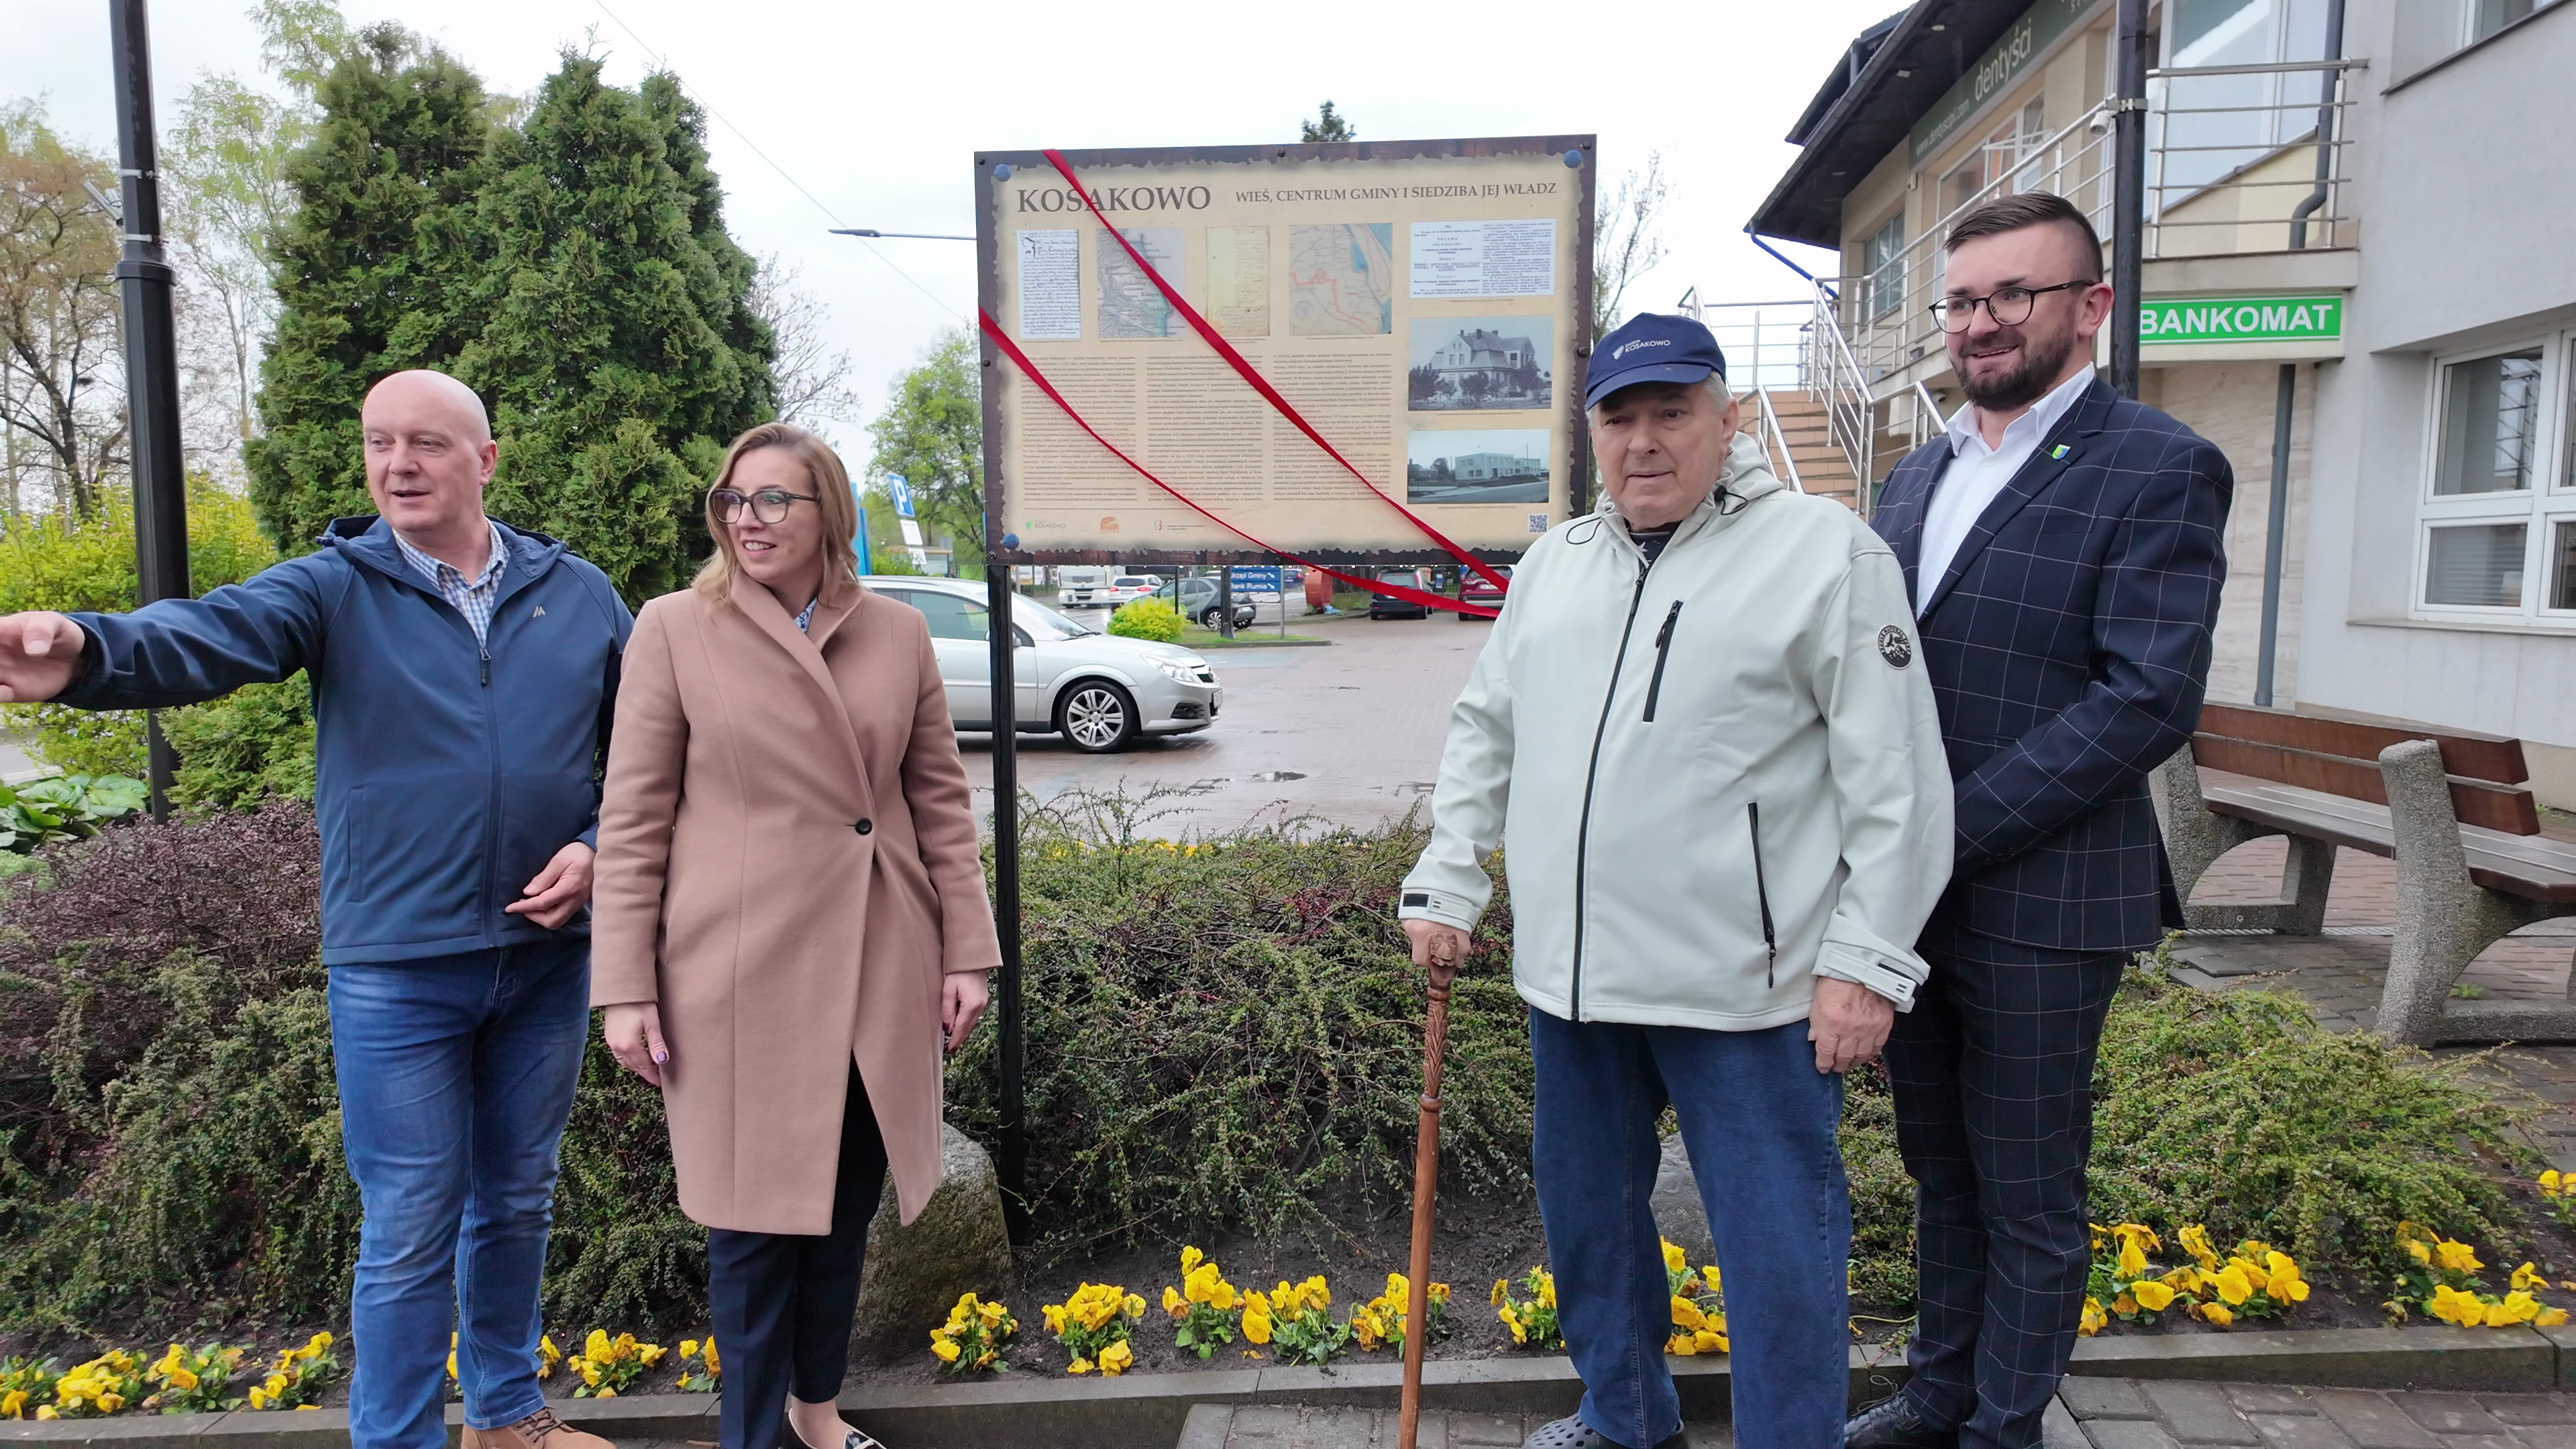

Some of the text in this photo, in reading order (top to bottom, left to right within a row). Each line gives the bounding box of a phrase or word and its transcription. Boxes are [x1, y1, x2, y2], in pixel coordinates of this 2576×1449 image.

[1975, 18, 2031, 101] dentyści
[1017, 186, 1211, 212] KOSAKOWO
[1236, 183, 1556, 203] WIEŚ, CENTRUM GMINY I SIEDZIBA JEJ WŁADZ
[2140, 305, 2332, 335] BANKOMAT
[1625, 340, 1670, 353] KOSAKOWO
[893, 478, 907, 511] P
